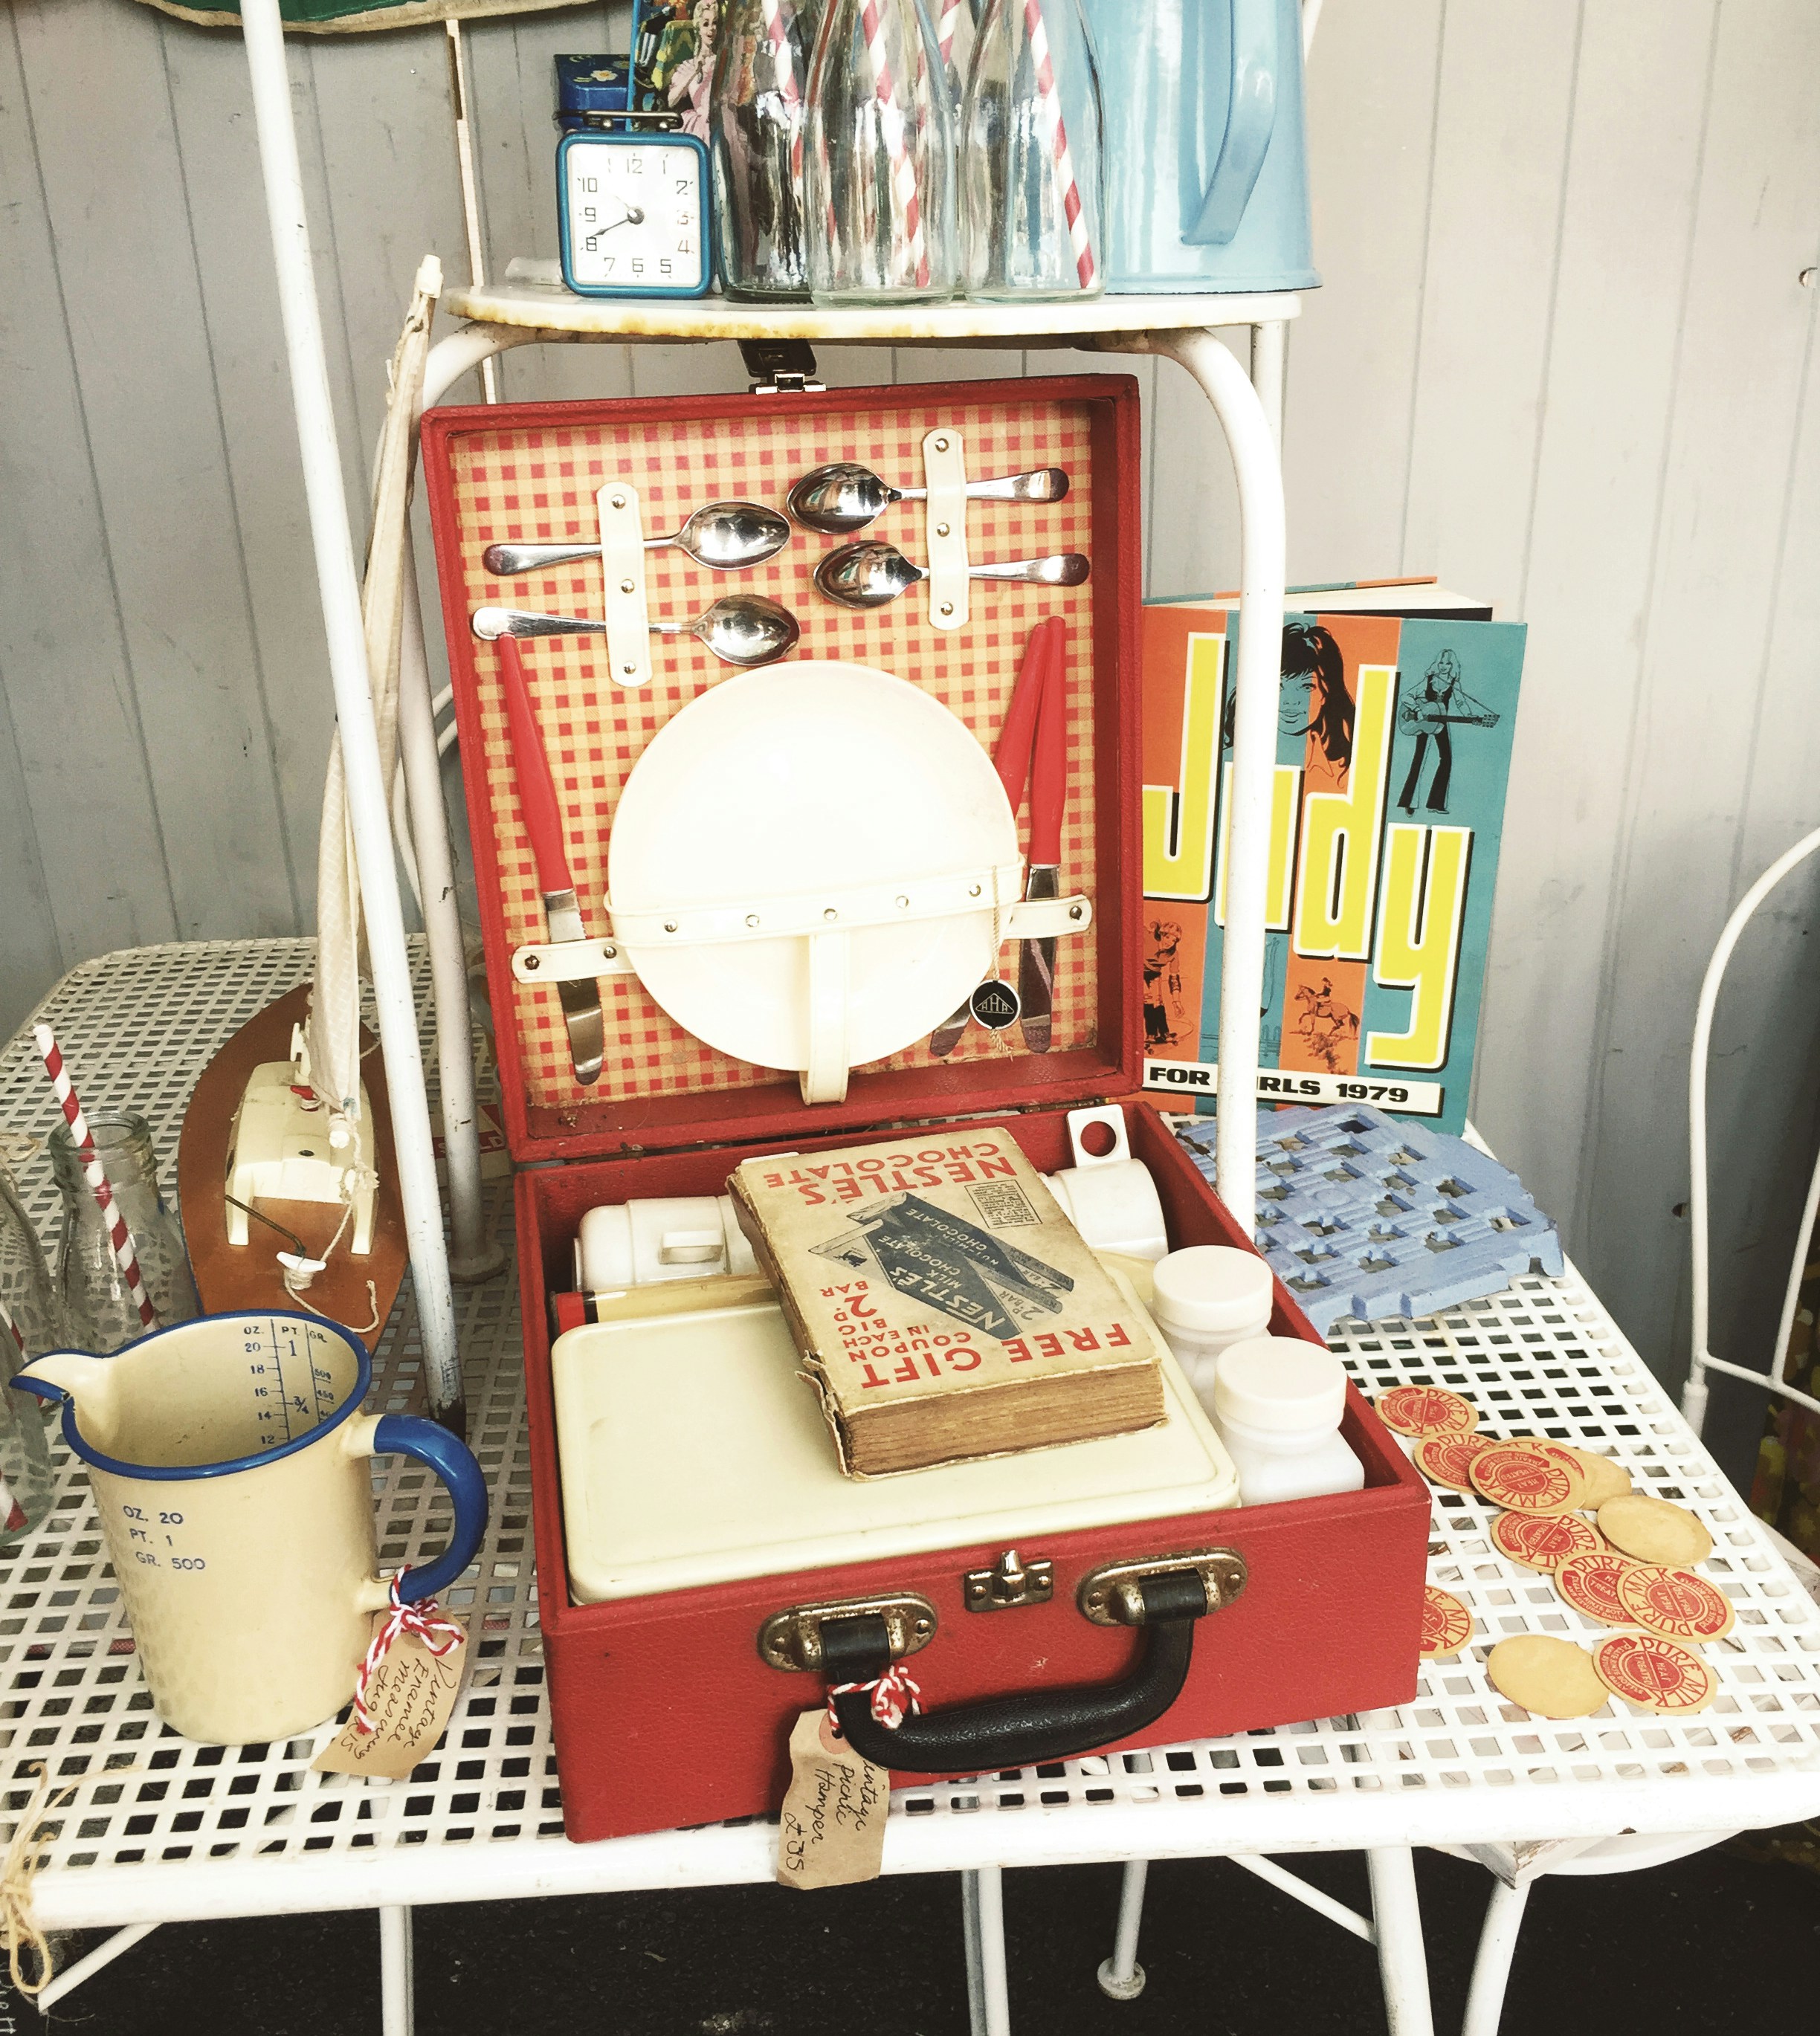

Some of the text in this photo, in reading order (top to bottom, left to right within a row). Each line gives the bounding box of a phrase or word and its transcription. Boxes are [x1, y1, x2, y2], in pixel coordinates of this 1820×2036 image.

[627, 158, 642, 174] 12
[582, 178, 598, 193] 10
[676, 180, 688, 195] 2
[584, 207, 596, 222] 9
[586, 237, 597, 251] 8
[677, 239, 690, 254] 4
[604, 257, 616, 272] 7
[632, 258, 644, 273] 6
[660, 259, 671, 274] 5
[981, 997, 1008, 1012] AHA
[1149, 1066, 1210, 1087] FOR
[1335, 1082, 1409, 1103] 1979
[764, 1143, 1000, 1188] CHOCOLATE
[906, 1208, 988, 1250] CHOCOLATE
[878, 1235, 961, 1276] CHOCOLATE
[926, 1269, 963, 1289] MILK
[819, 1280, 868, 1297] BAR
[999, 1290, 1024, 1306] BAR
[838, 1318, 888, 1336] BIG
[843, 1324, 929, 1348] IN EACH
[245, 1339, 297, 1357] 20 1
[849, 1331, 971, 1363] COUPON
[861, 1323, 1132, 1389] FREE GIFT
[250, 1365, 265, 1374] 18
[254, 1388, 268, 1397] 16
[257, 1410, 272, 1421] 14
[260, 1435, 275, 1444] 12
[159, 1512, 184, 1525] 20
[165, 1534, 172, 1547] 1
[172, 1558, 205, 1570] 500
[1639, 1636, 1708, 1707] PURE MILK
[855, 1759, 888, 1832] intage
